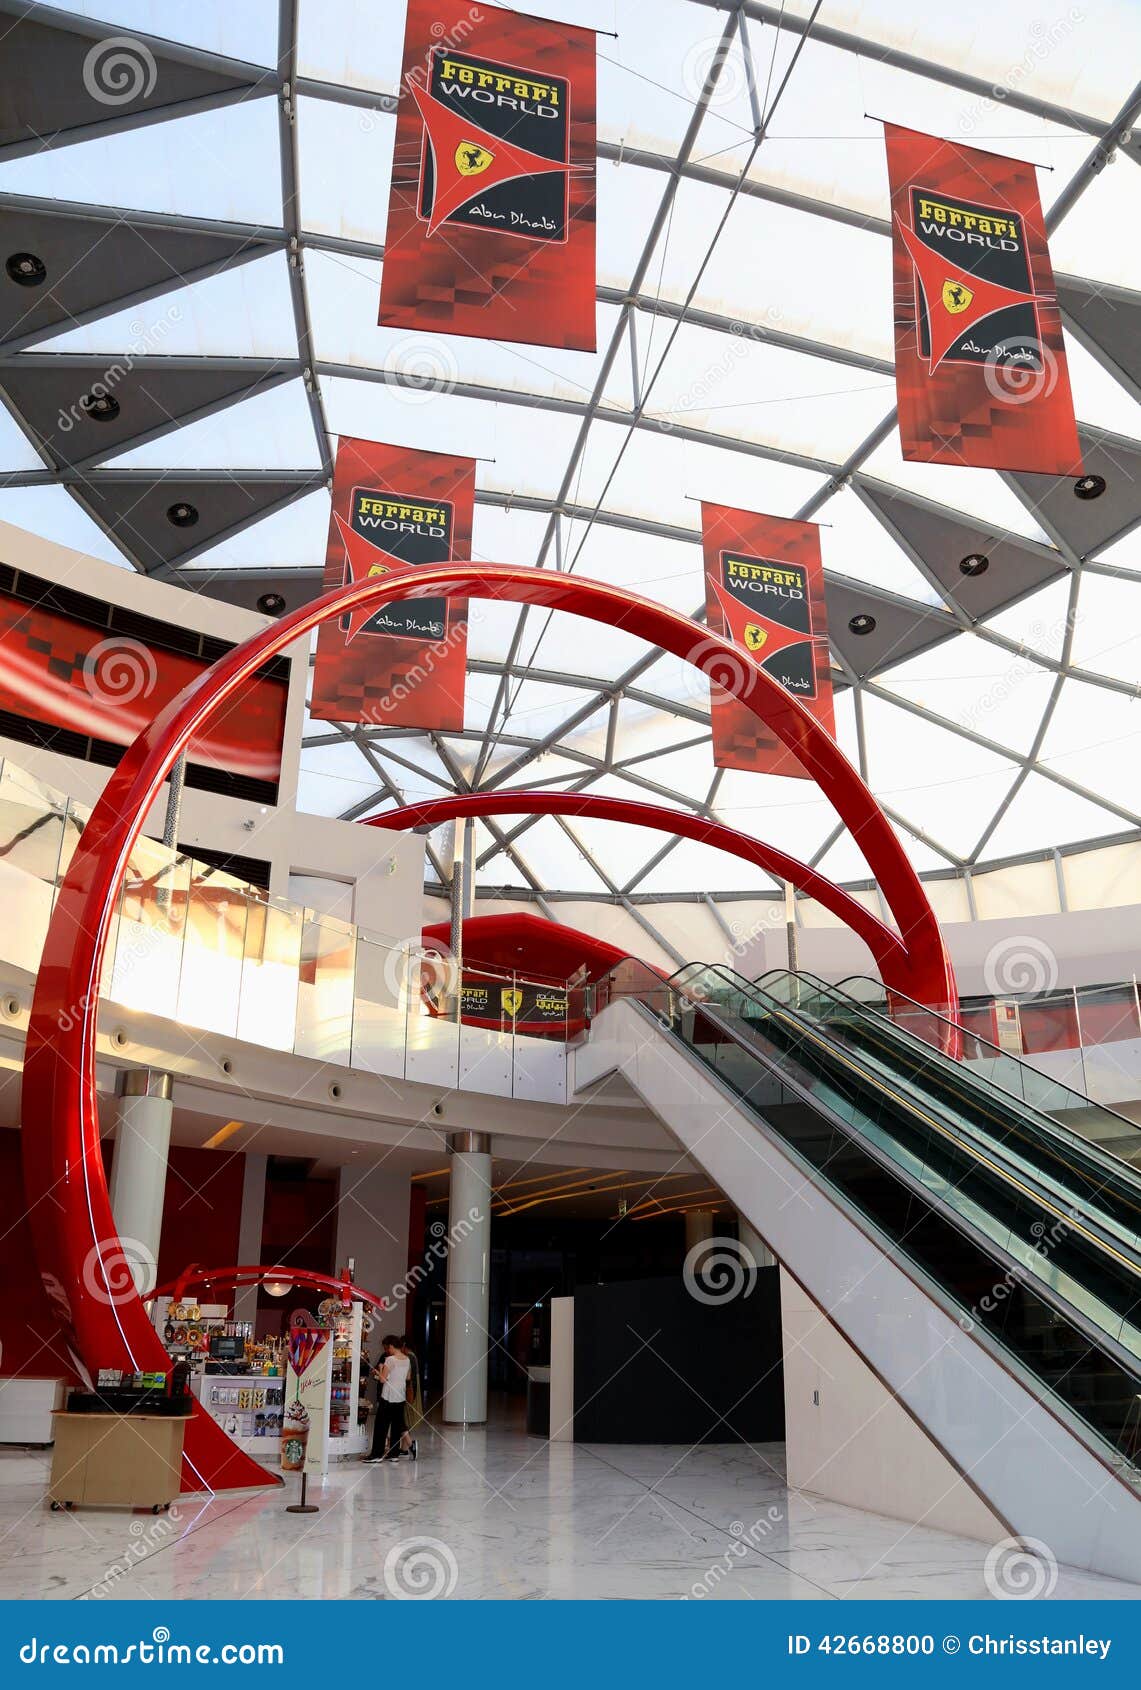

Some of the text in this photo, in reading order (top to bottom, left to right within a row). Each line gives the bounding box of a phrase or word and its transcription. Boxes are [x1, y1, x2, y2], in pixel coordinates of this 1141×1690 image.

[440, 60, 559, 105] Ferrari
[440, 81, 559, 119] WORLD
[469, 204, 556, 230] Abu Dhabi
[919, 199, 1018, 239] Ferrari
[920, 221, 1019, 252] WORLD
[961, 339, 1035, 361] Abu Dhabi
[359, 498, 446, 525] Ferrari
[358, 515, 446, 538] WORLD
[727, 560, 803, 588] Ferrari
[728, 577, 803, 600] WORLD
[376, 615, 440, 632] Abu Dhabi
[781, 675, 811, 689] Dhabi
